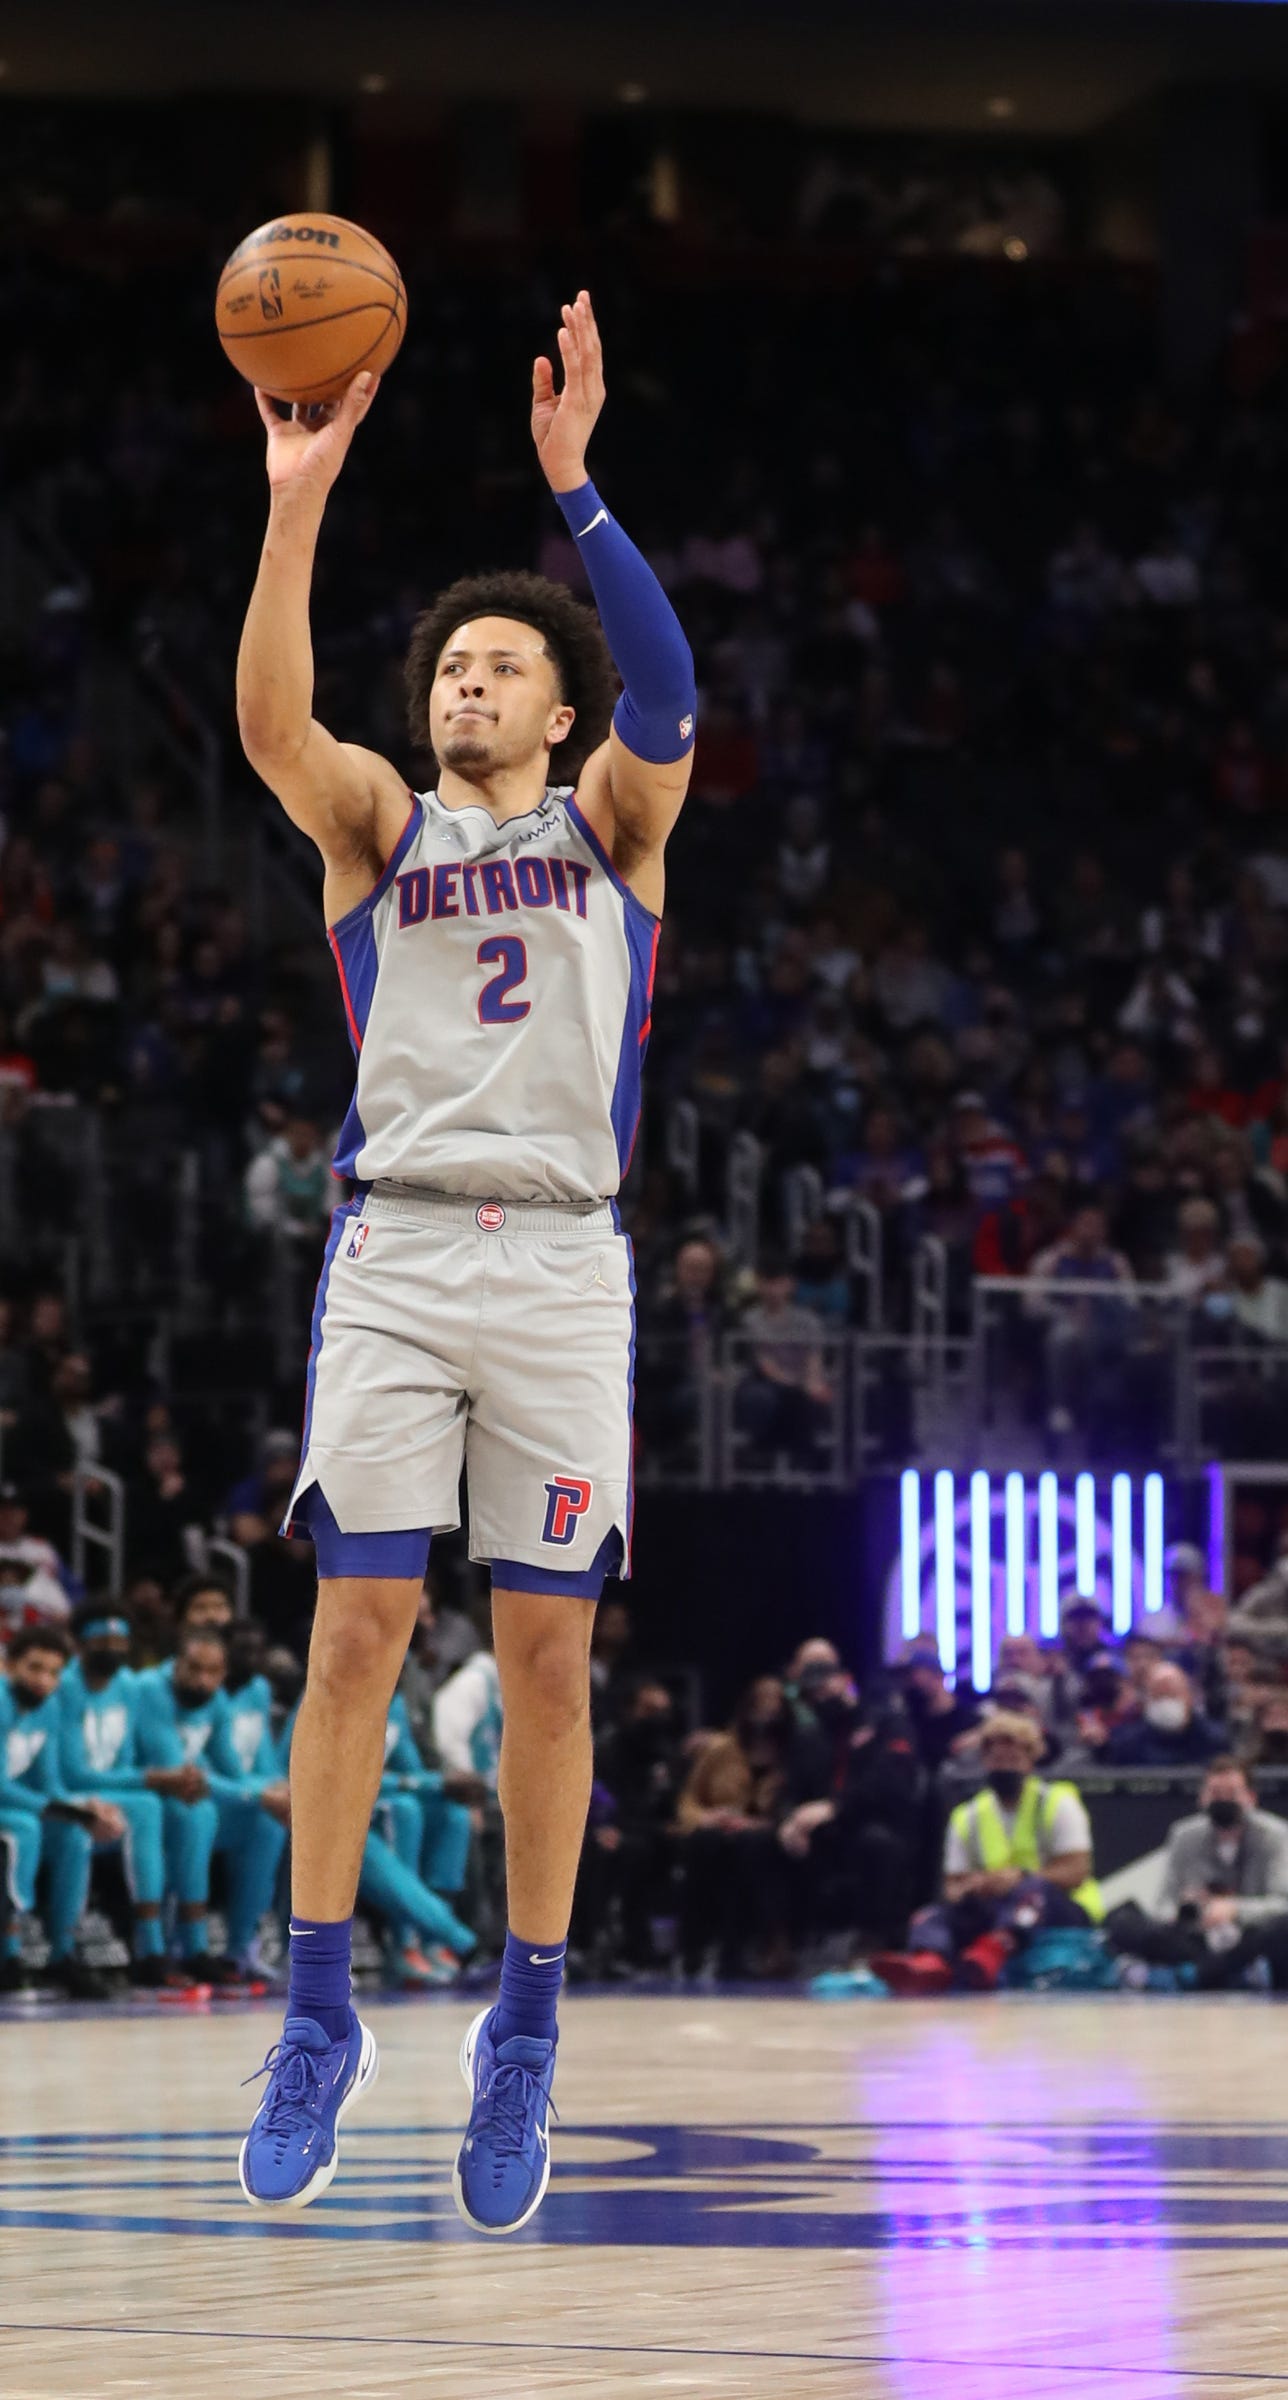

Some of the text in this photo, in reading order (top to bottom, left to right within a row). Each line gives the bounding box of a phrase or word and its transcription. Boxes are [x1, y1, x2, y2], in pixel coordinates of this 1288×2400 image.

[231, 224, 339, 263] lson
[518, 814, 561, 842] UWM
[395, 856, 592, 930] DETROIT
[477, 935, 531, 1025] 2
